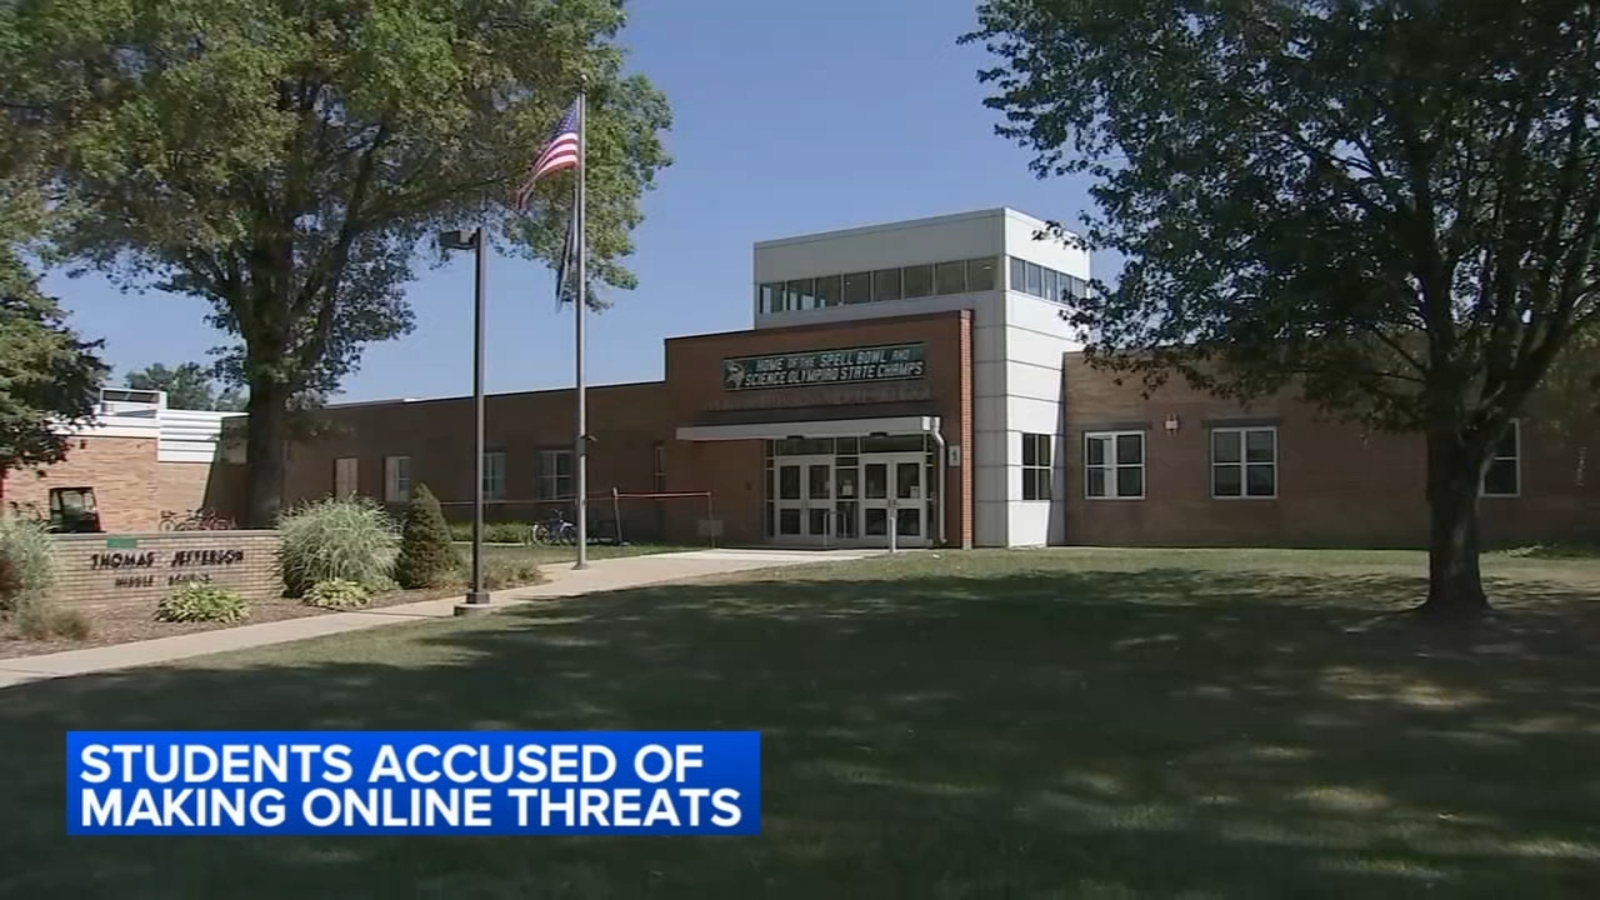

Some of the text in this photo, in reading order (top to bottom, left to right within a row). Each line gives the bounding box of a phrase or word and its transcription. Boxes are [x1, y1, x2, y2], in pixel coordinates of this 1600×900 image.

[820, 353, 854, 367] SPELL
[856, 350, 886, 364] BOWL
[745, 371, 786, 386] SCIENCE
[840, 365, 875, 380] STATE
[877, 361, 923, 377] CHAMPS
[91, 550, 244, 570] THOMAS JEFFERSON
